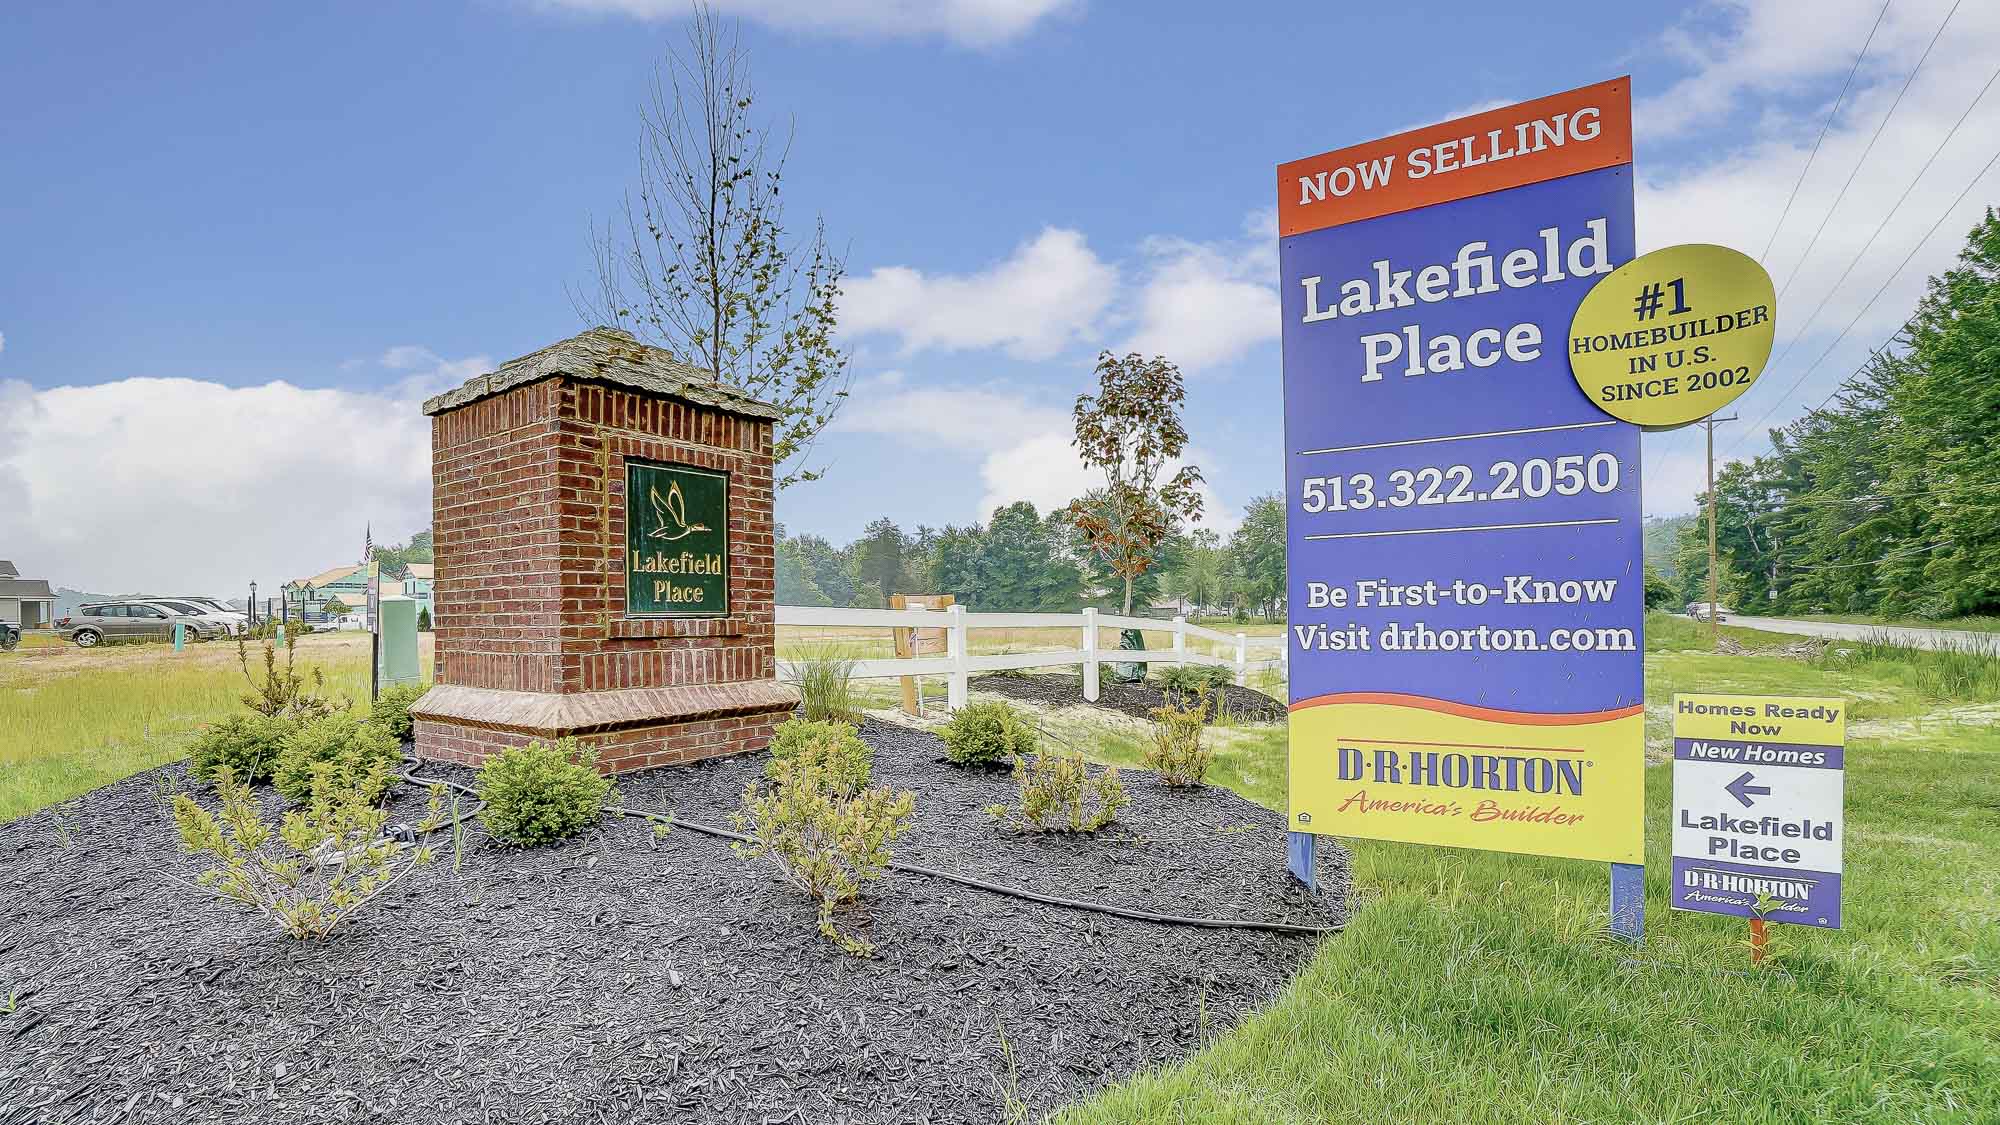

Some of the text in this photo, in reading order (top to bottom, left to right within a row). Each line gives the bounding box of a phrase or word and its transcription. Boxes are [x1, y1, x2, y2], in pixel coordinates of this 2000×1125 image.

[1299, 107, 1601, 205] NOW SELLING
[1301, 218, 1614, 323] Lakefield
[1633, 277, 1692, 321] #1
[1573, 304, 1768, 353] HOMEBUILDER
[1360, 321, 1542, 383] Place
[1629, 345, 1716, 374] IN U.S.
[1601, 366, 1751, 402] SINCE 2002
[1303, 452, 1620, 513] 513.322.2050
[632, 550, 722, 575] Lakefield
[653, 579, 704, 602] Place
[1307, 575, 1618, 608] Be First-to-Know
[1295, 622, 1637, 652] Visit drhorton.com
[1679, 700, 1840, 723] Homes Ready
[1730, 721, 1782, 736] Now
[1689, 742, 1825, 765] New Homes
[1337, 789, 1585, 826] America's Builder
[1681, 809, 1833, 841] Lakefield
[1708, 836, 1801, 864] Place
[1684, 889, 1749, 906] America's
